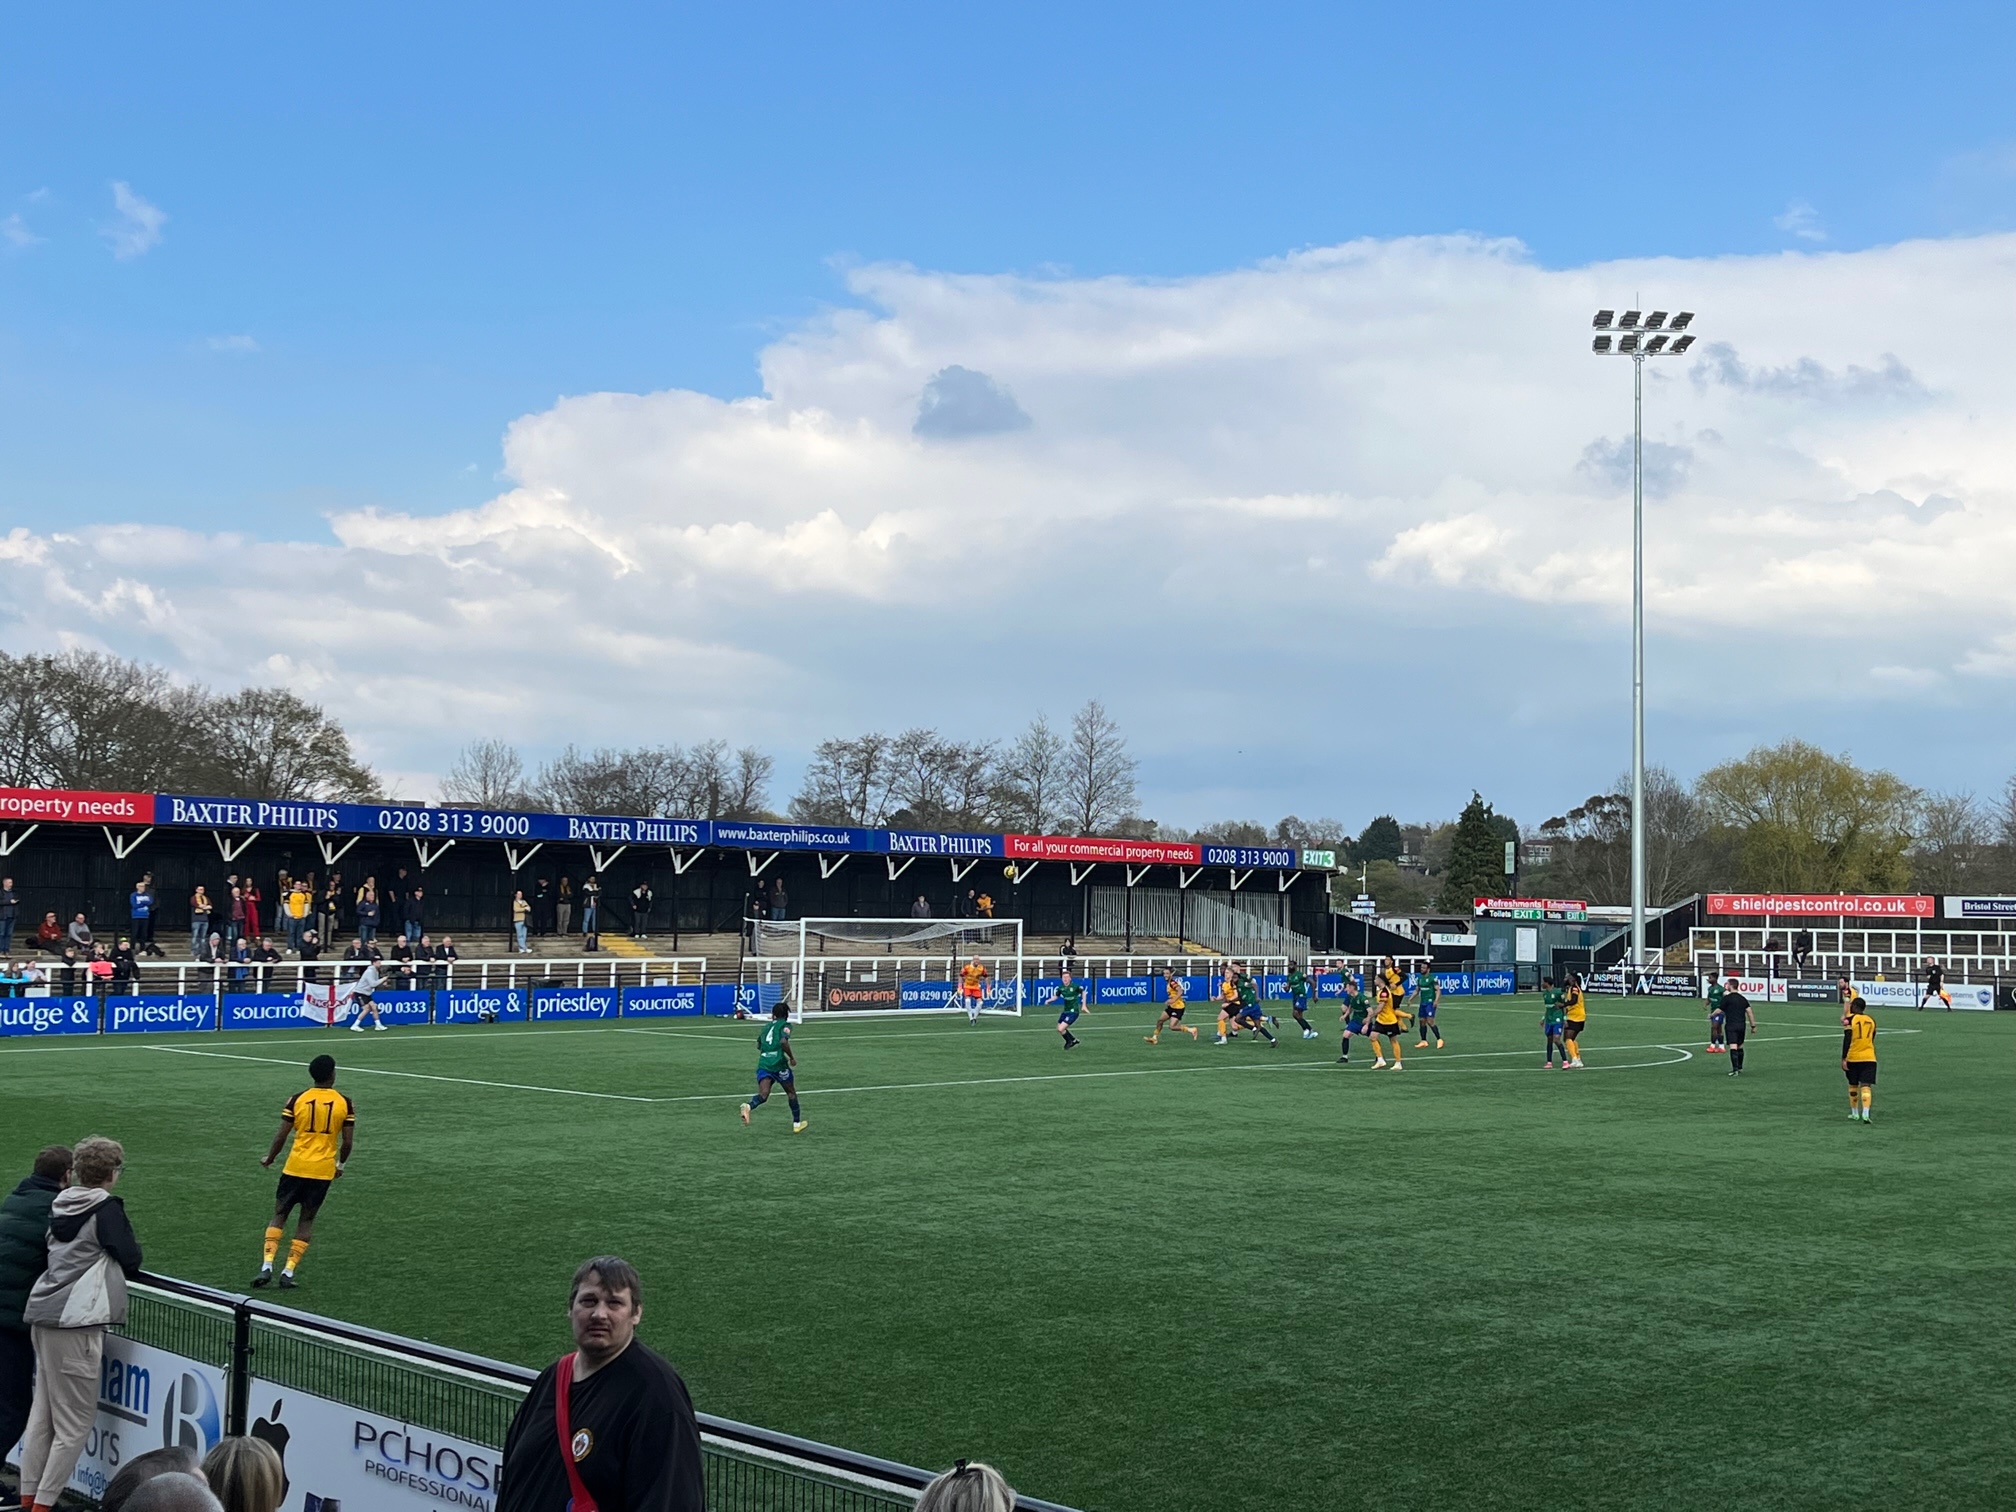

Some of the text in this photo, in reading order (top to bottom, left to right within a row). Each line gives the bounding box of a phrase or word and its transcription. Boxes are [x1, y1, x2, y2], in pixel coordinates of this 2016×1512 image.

[78, 799, 135, 816] needs
[172, 799, 338, 828] BAXTER PHILIPS
[379, 810, 529, 835] 0208 313 9000
[568, 818, 698, 843] BAXTER PHILIPS
[718, 827, 851, 846] www.baxterphilips.co.uk
[889, 832, 992, 855] BAXTER PHILIPS
[1014, 839, 1194, 861] For all your commercial property needs
[1208, 848, 1290, 866] 0208 313 9000
[1303, 850, 1335, 868] EXIT 3
[1487, 899, 1542, 908] Refreshments
[1732, 898, 1906, 913] shieldpestcontrol.co.uk
[1964, 901, 1991, 911] Bristol
[1489, 910, 1512, 918] Toilets
[1514, 909, 1542, 919] EXIT 3
[1567, 911, 1580, 920] EXIT
[1441, 934, 1455, 943] EXIT
[1462, 974, 1470, 989] &
[1476, 975, 1513, 993] priestley
[1593, 973, 1624, 982] INSPIRE
[1657, 976, 1689, 985] INSPIRE
[842, 989, 896, 1002] vanarama
[903, 991, 918, 1001] 020
[920, 991, 941, 1001] 8290
[981, 981, 1014, 1005] udge
[1101, 985, 1147, 998] SOLICITORS
[1771, 984, 1785, 993] LK
[71, 1001, 90, 1024] &
[395, 1001, 427, 1014] 0333
[446, 992, 521, 1019] judge &
[536, 992, 612, 1019] priestley
[629, 998, 695, 1011] SOLICITORS
[113, 999, 210, 1030] priestley
[765, 1025, 775, 1045] 4
[1855, 1020, 1873, 1040] 17
[304, 1098, 334, 1135] 11
